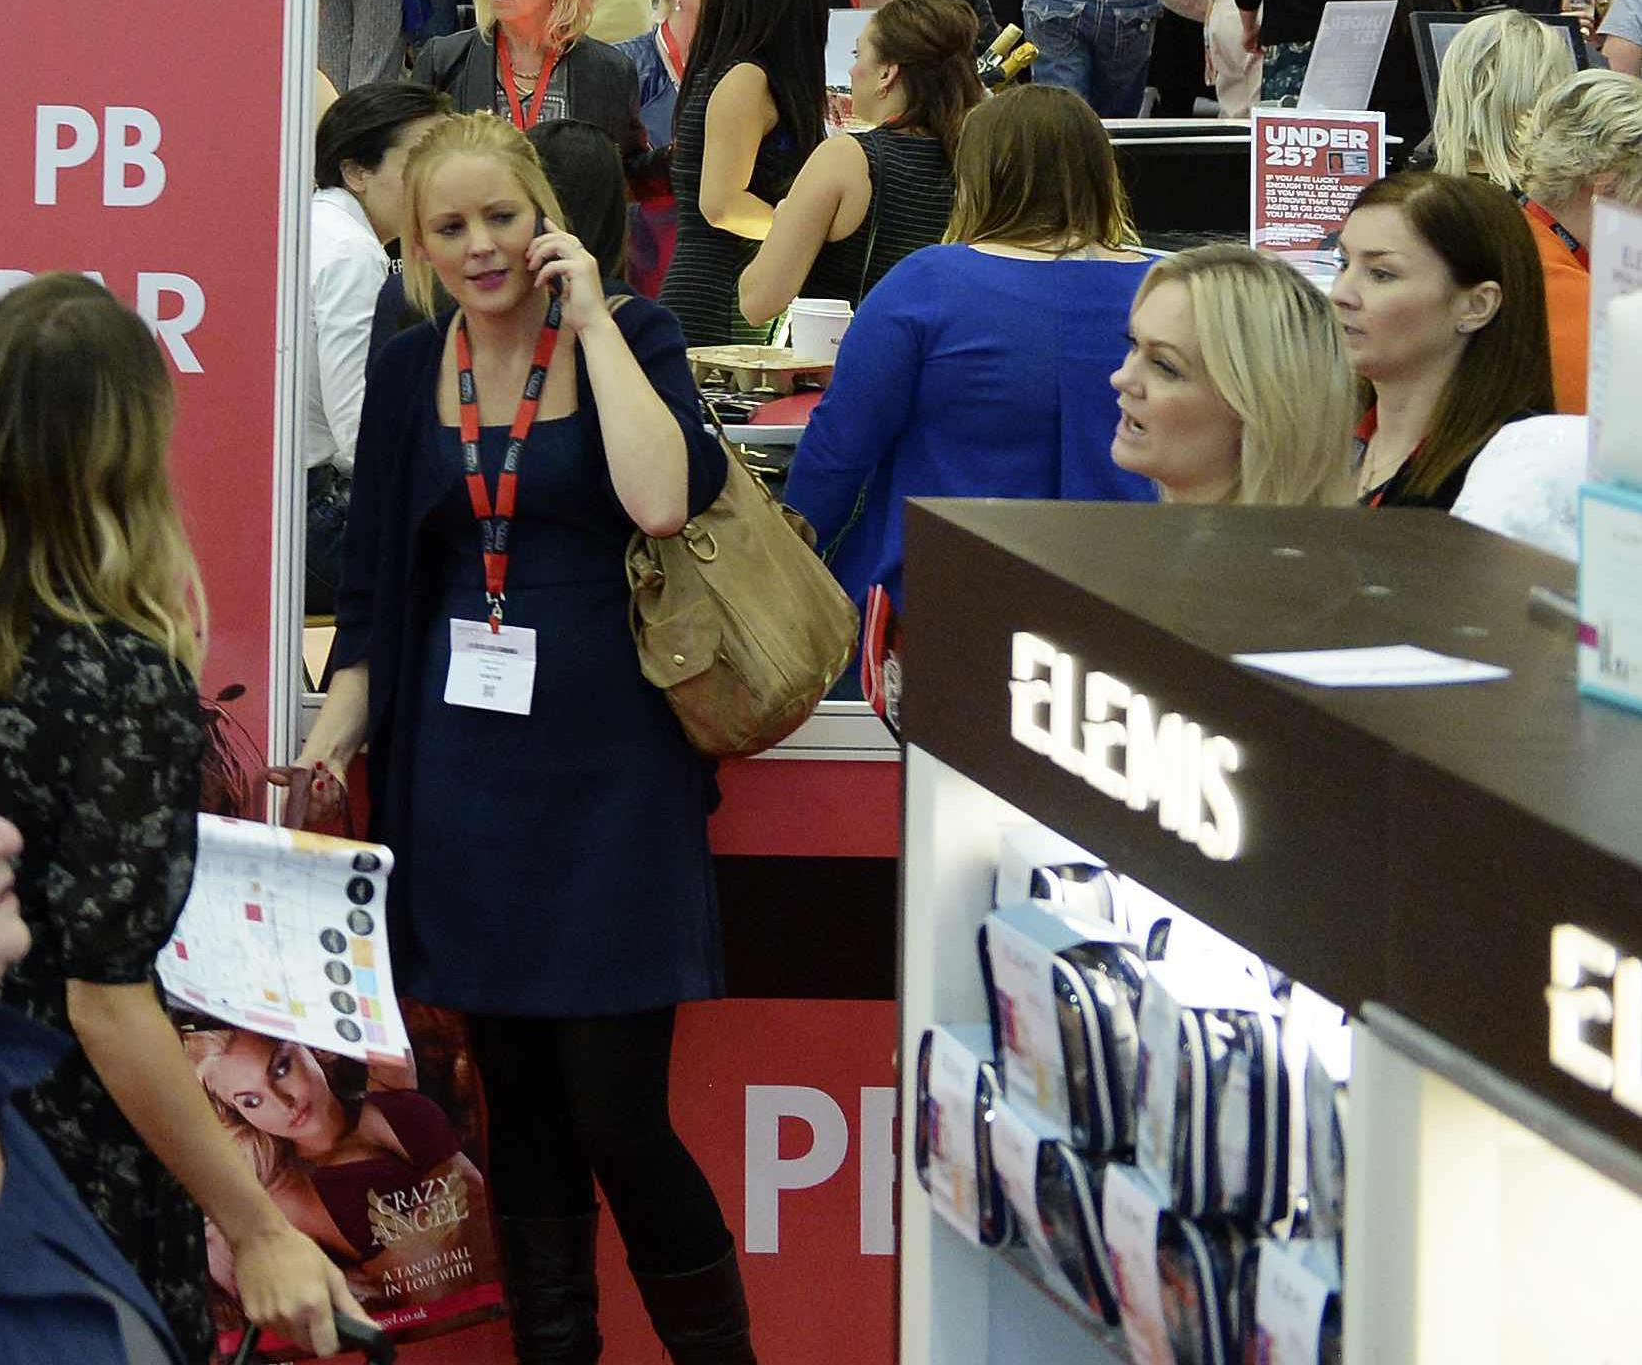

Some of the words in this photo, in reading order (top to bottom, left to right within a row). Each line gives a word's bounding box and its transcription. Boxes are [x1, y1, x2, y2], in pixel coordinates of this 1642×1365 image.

[1265, 125, 1370, 150] UNDER
[34, 104, 167, 207] PB
[1265, 146, 1317, 167] 25?
[1294, 175, 1311, 183] ARE
[1312, 176, 1340, 184] LUCKY
[1296, 190, 1316, 198] WILL
[1265, 204, 1288, 212] AGED
[1308, 198, 1329, 206] THAT
[1008, 631, 1241, 862] ELEMIS
[377, 1174, 453, 1215] CRAZY
[371, 1196, 469, 1246] ANGEL
[383, 1270, 393, 1283] A
[396, 1262, 422, 1279] TAN
[425, 1254, 441, 1271] TO
[443, 1246, 471, 1265] FALL
[385, 1284, 403, 1298] IN
[407, 1274, 436, 1292] LOVE
[439, 1261, 473, 1283] WITH
